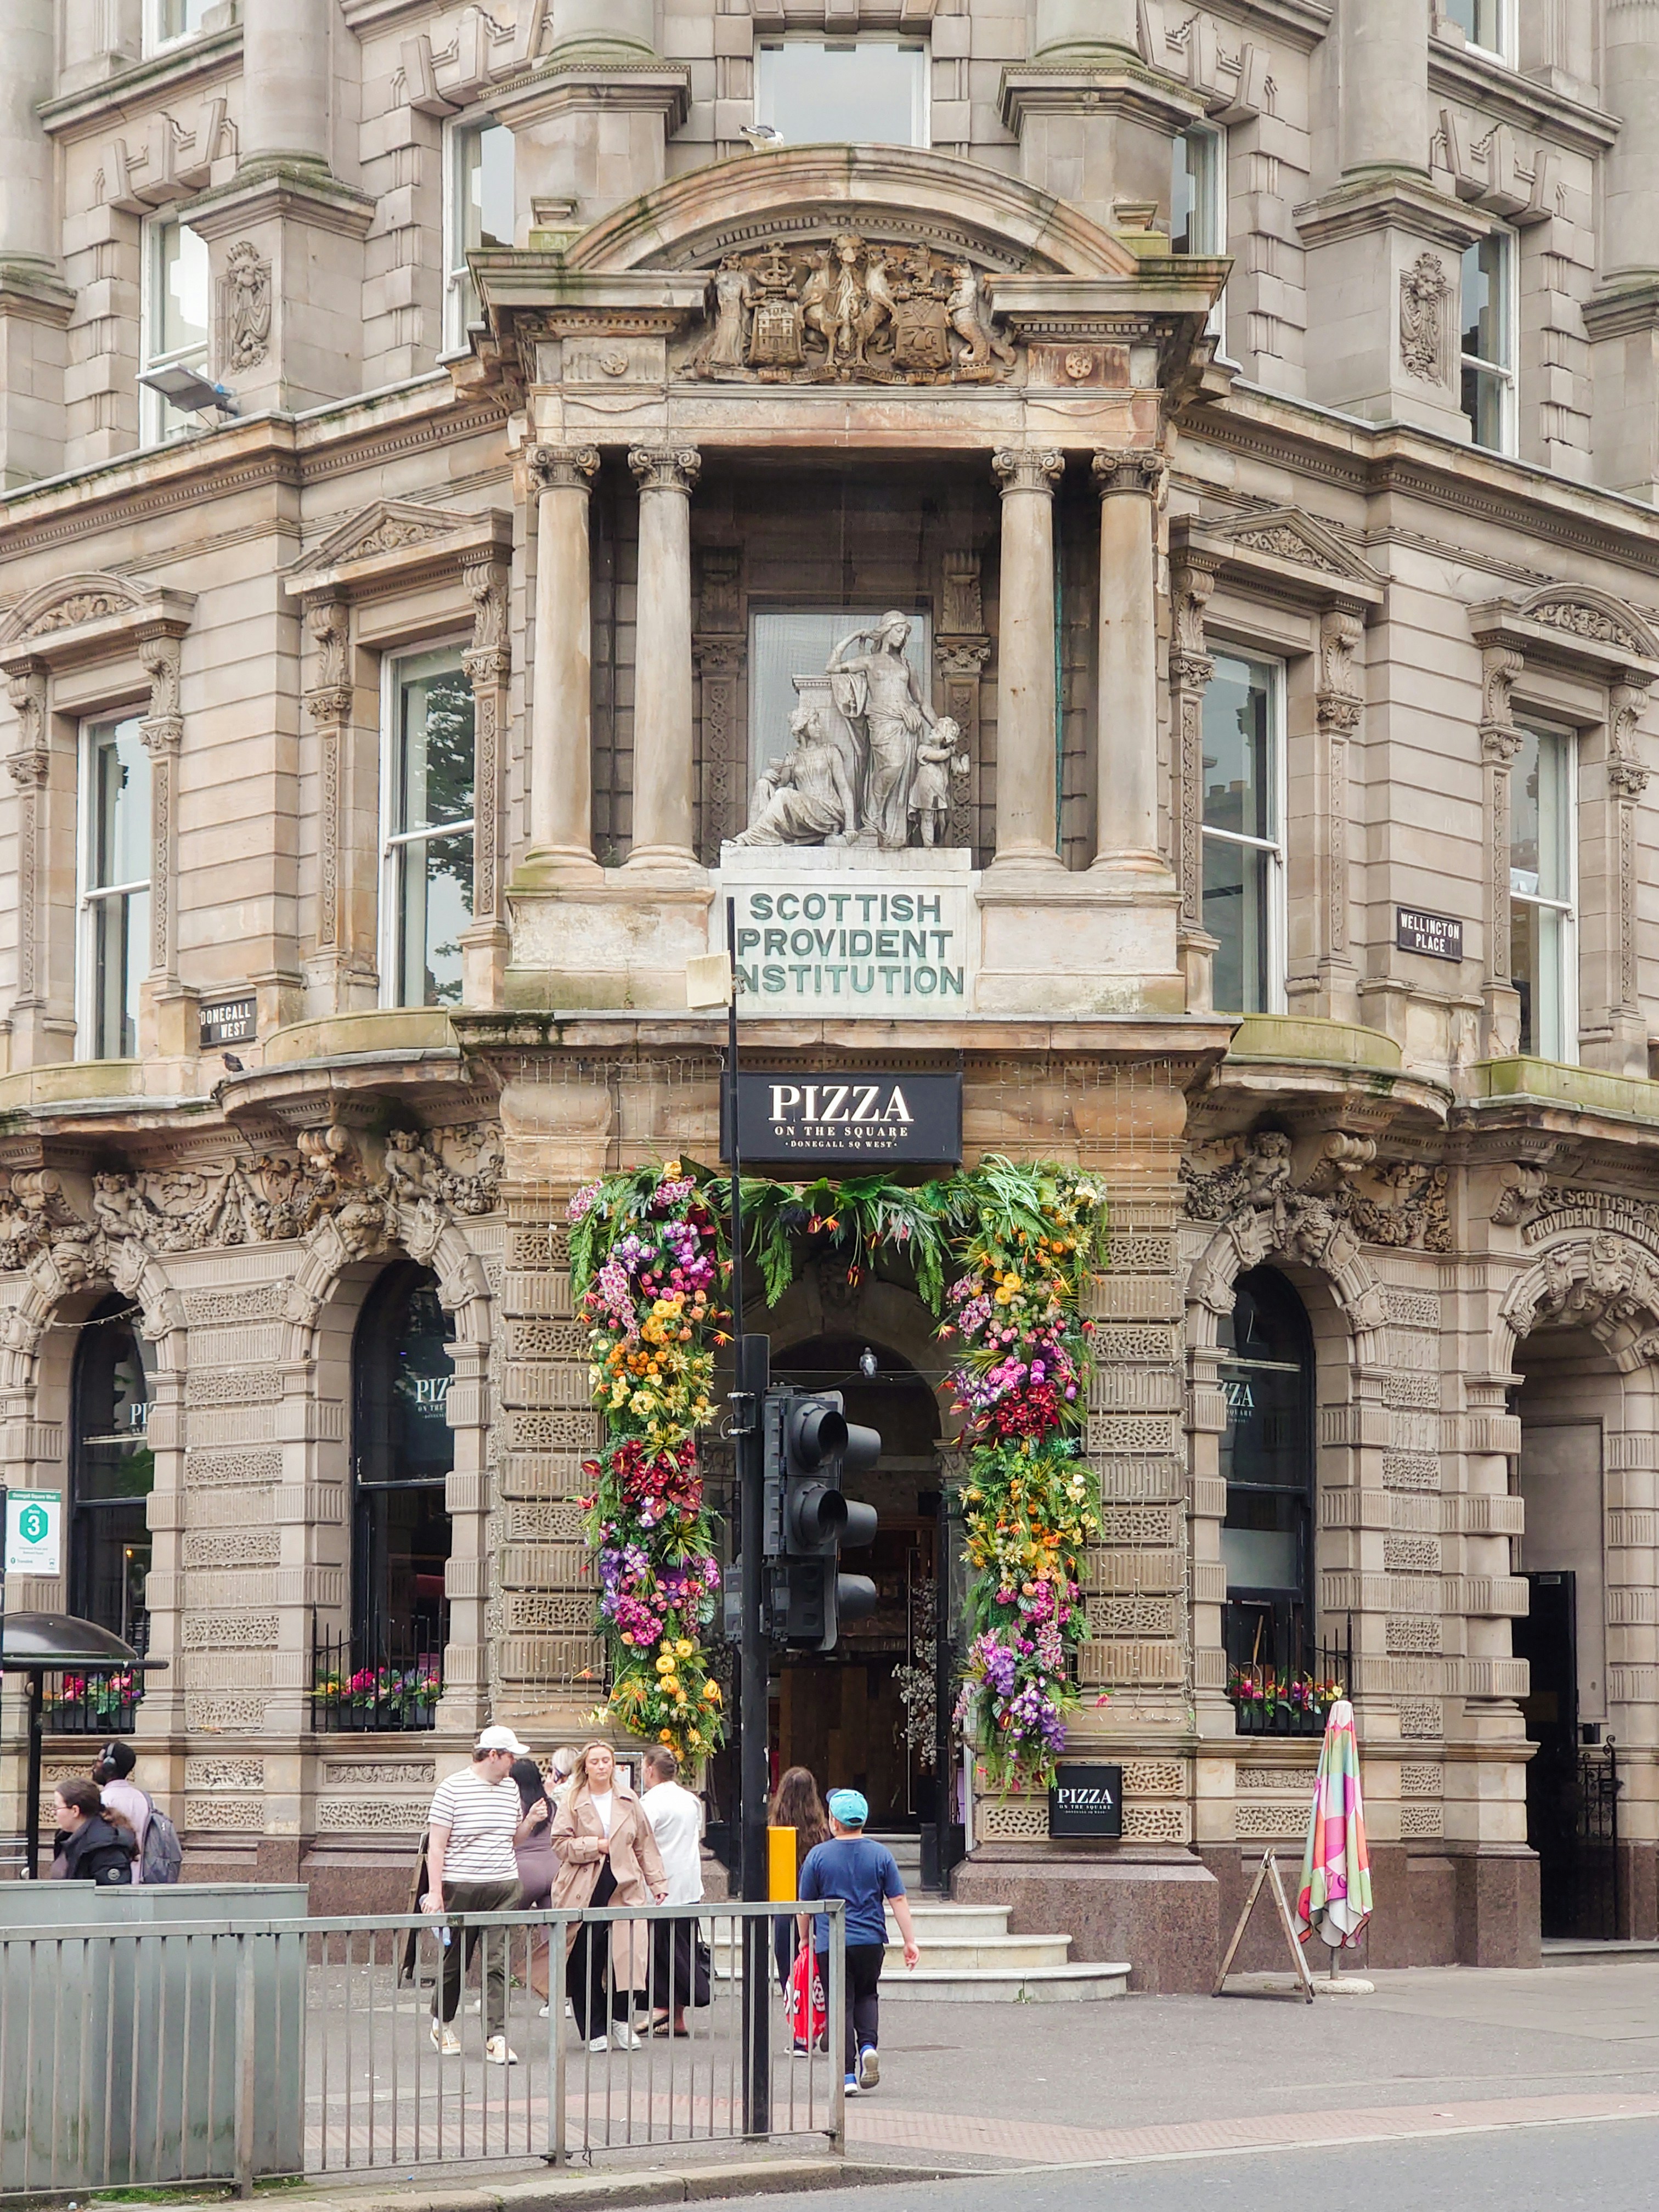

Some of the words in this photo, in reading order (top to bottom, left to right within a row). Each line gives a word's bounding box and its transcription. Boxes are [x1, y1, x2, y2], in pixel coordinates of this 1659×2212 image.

[749, 893, 941, 922] SCOTTISH
[1401, 913, 1459, 939] WELLINGTON
[737, 928, 953, 957] PROVIDENT
[1416, 933, 1445, 952] PLACE
[735, 964, 964, 994] NSTITUTION
[200, 1003, 251, 1026] DONEGALL
[221, 1020, 246, 1039] WEST
[768, 1085, 915, 1122] PIZZA
[774, 1125, 795, 1136] ON
[804, 1126, 836, 1137] THE
[844, 1126, 909, 1138] SQUARE
[848, 1141, 861, 1149] SQ
[1567, 1189, 1634, 1213] SCOTTISH
[1527, 1207, 1600, 1244] PROVIDENT
[27, 1514, 41, 1537] 3
[1057, 1788, 1114, 1804] PIZZA
